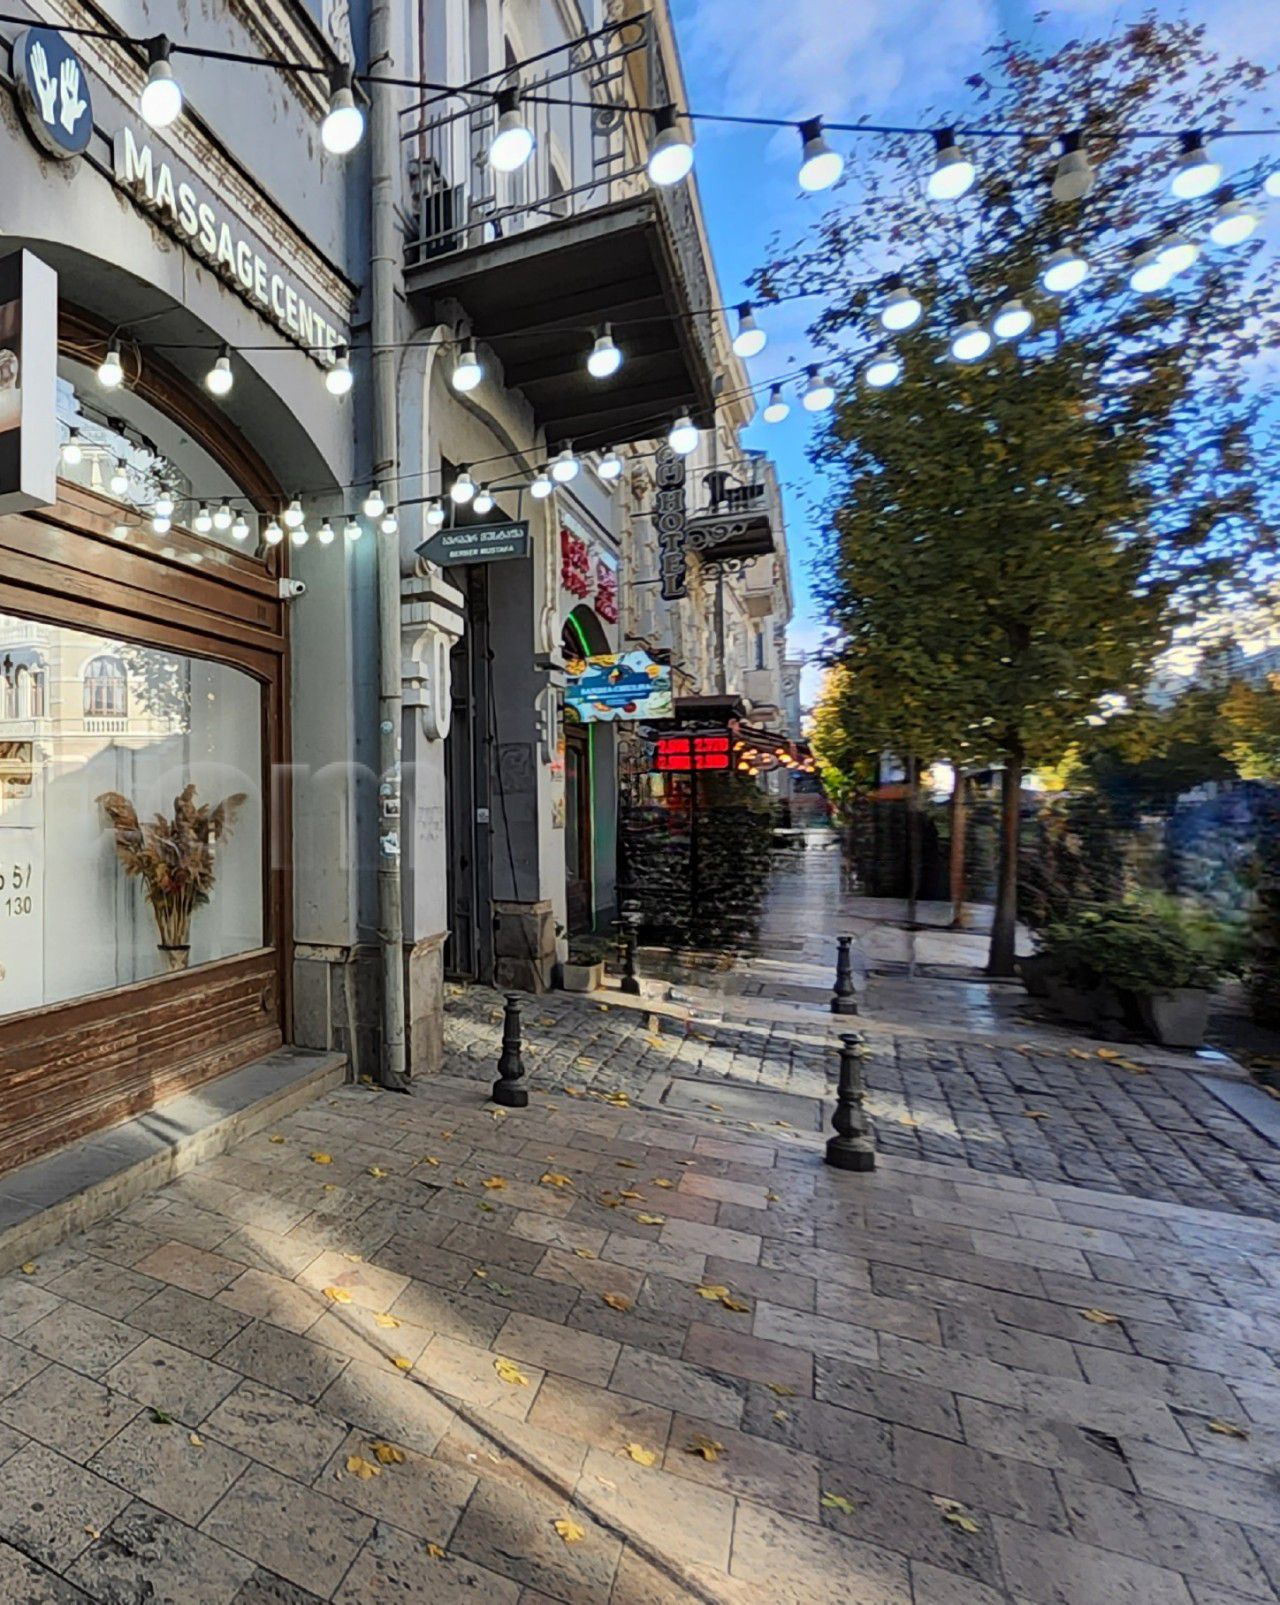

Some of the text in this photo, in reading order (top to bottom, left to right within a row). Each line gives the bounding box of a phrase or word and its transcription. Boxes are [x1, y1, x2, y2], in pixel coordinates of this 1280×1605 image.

[120, 126, 269, 306] MASSAGE
[658, 490, 687, 597] HOTEL
[5, 895, 32, 917] 130
